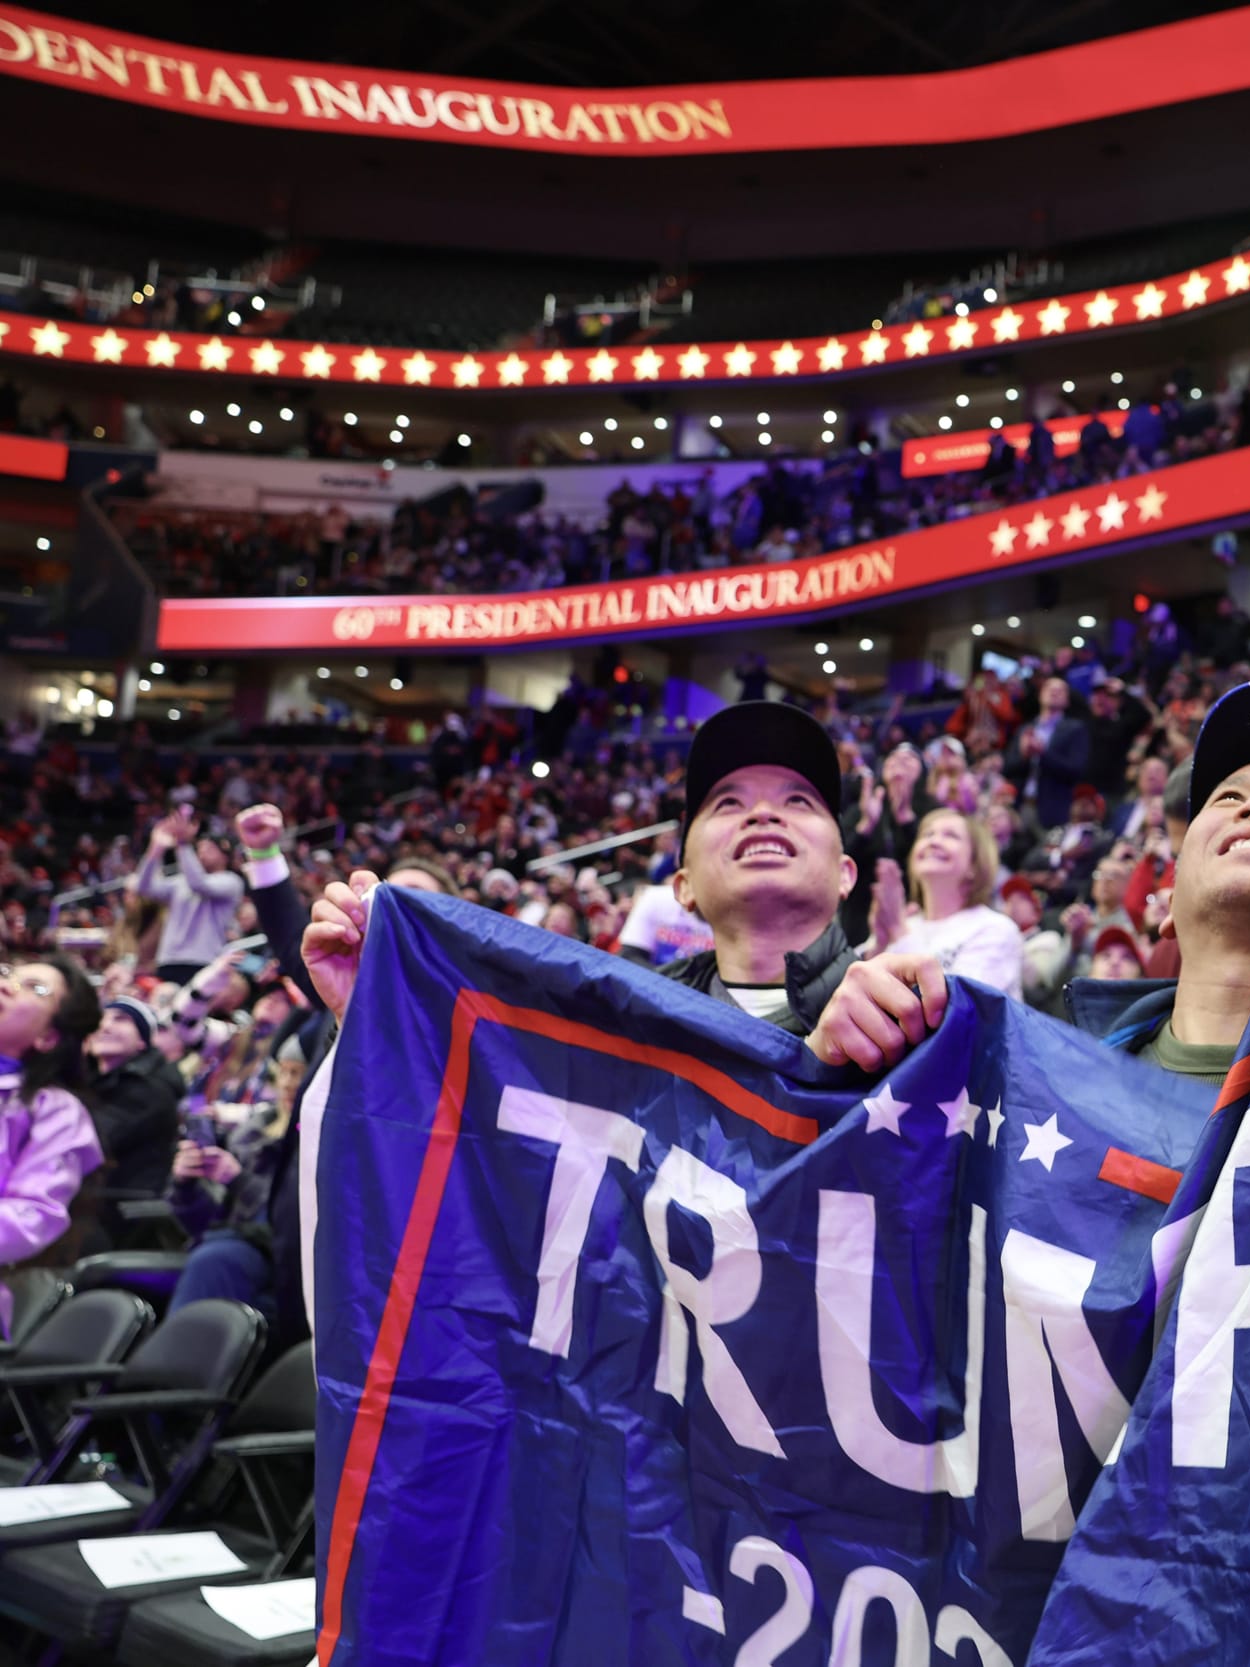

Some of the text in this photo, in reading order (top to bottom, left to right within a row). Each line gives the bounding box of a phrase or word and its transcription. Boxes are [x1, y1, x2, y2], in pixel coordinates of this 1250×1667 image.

[289, 74, 733, 144] INAUGURATION
[332, 547, 897, 640] 60TH PRESIDENTIAL INAUGURATION
